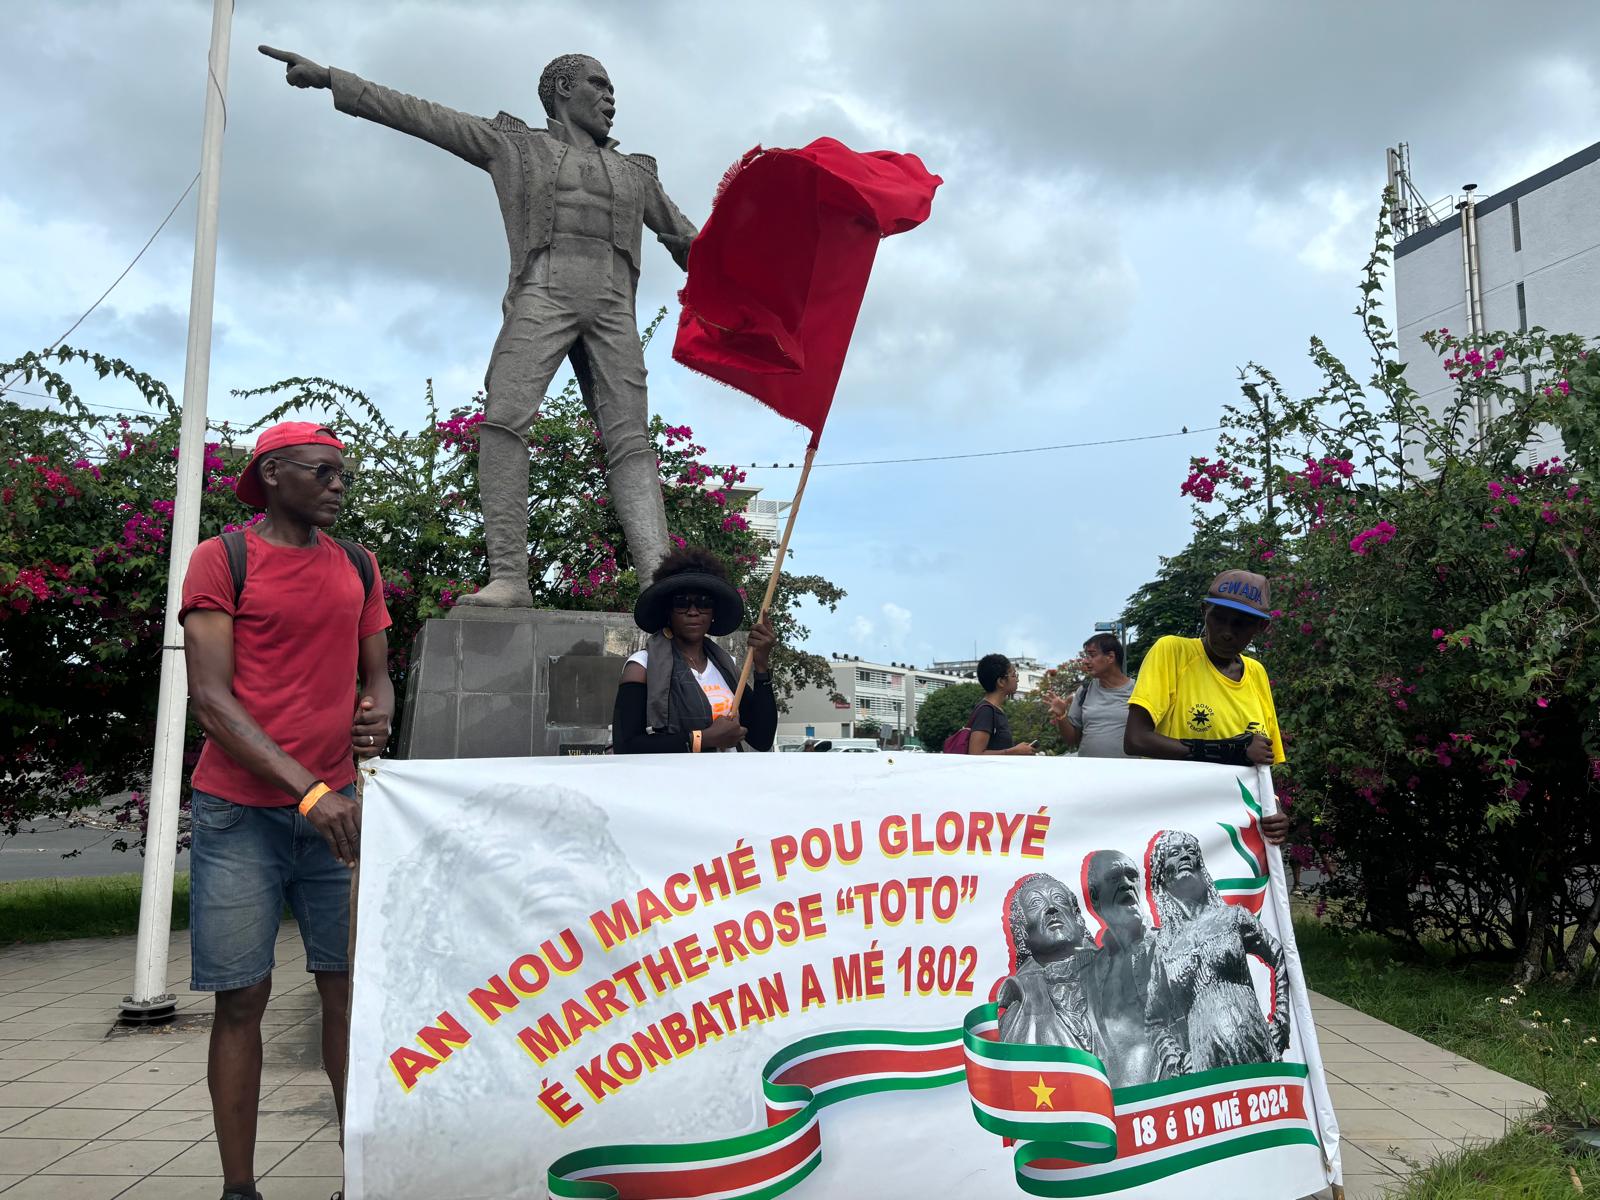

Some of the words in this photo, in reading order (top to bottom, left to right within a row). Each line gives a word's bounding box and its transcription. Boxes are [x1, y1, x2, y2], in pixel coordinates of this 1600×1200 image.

[1218, 581, 1262, 604] GWADA
[1195, 703, 1215, 717] RONDE
[388, 1010, 472, 1093] AN
[466, 928, 584, 1024] NOU
[588, 838, 763, 952] MACHÉ
[769, 820, 864, 880] POU
[877, 806, 1051, 860] GLORYÉ
[515, 893, 827, 1067] MARTHE-ROSE
[836, 875, 979, 929] “TOTO”
[536, 1078, 585, 1128] É
[574, 972, 791, 1104] KONBATAN
[800, 963, 827, 1011] A
[833, 940, 885, 1002] MÉ
[897, 945, 978, 998] 1802
[1132, 1115, 1157, 1147] 18
[1165, 1110, 1178, 1140] é
[1184, 1105, 1206, 1136] 19
[1212, 1091, 1242, 1130] MÉ
[1247, 1085, 1289, 1122] 2024
